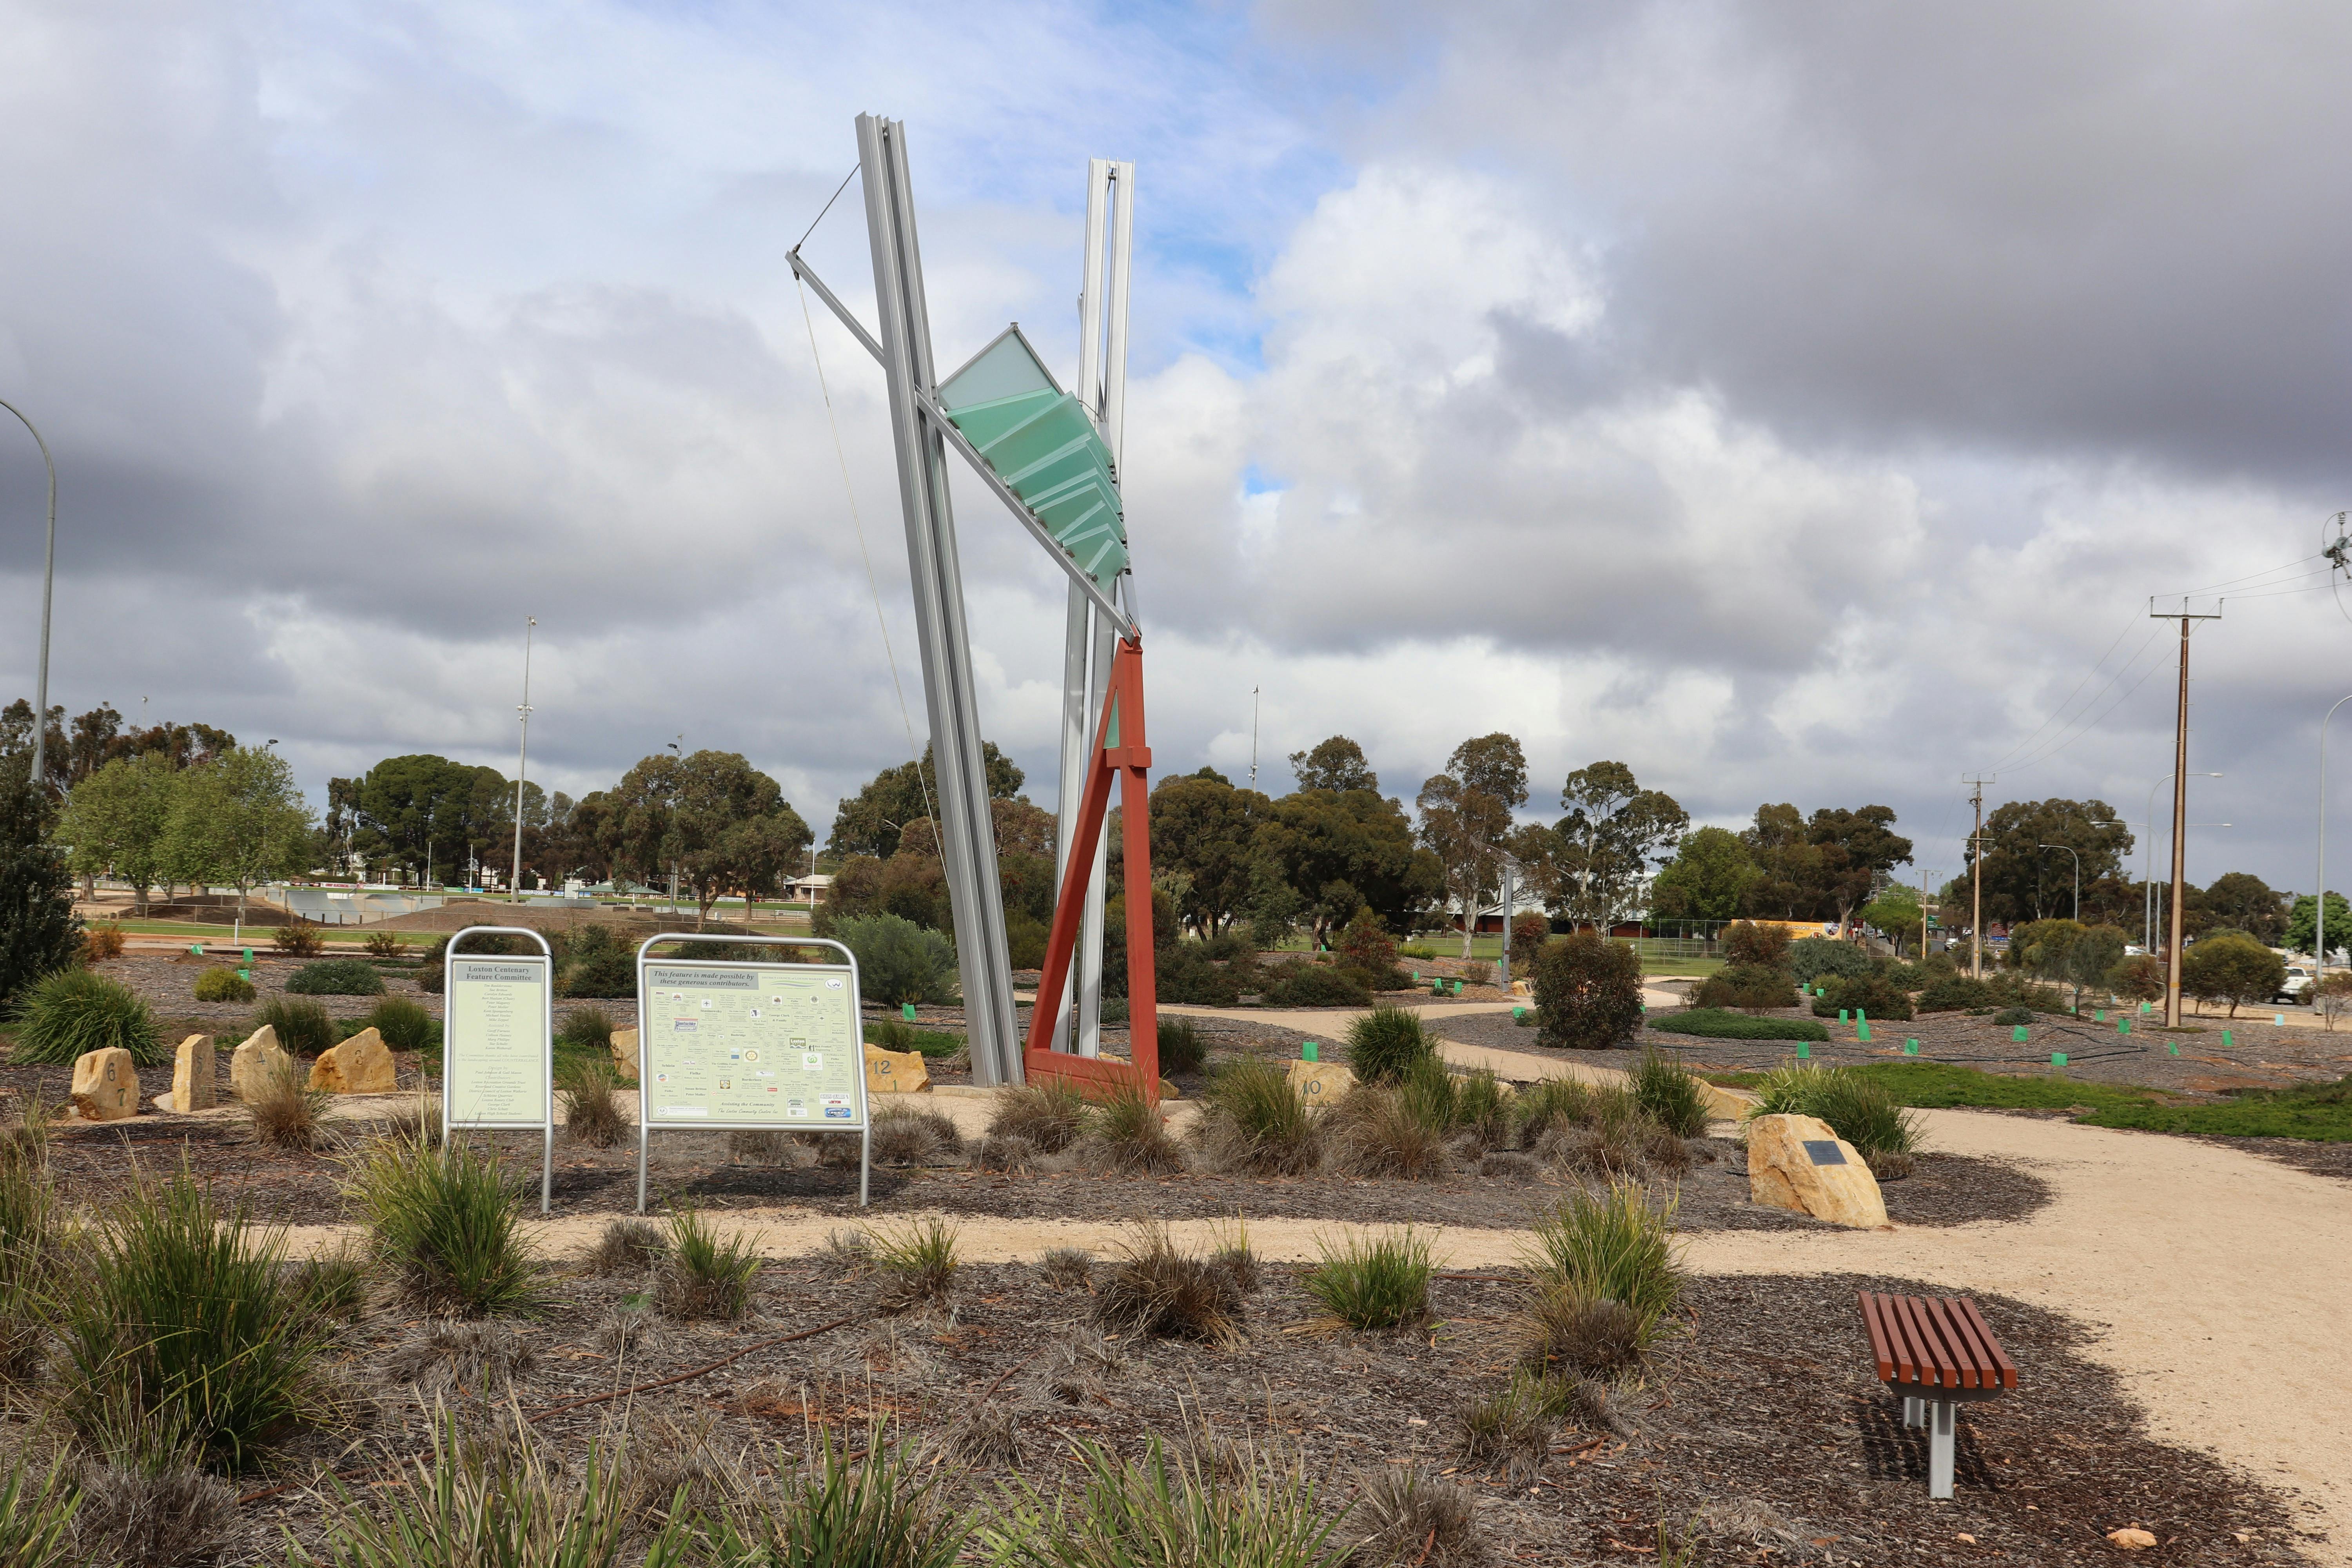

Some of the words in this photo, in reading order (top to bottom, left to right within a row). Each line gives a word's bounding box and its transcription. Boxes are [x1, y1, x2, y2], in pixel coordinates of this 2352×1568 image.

[256, 1051, 266, 1065] 4
[354, 1049, 364, 1065] 3
[107, 1062, 116, 1082] 6
[197, 1056, 203, 1074] 5
[874, 1060, 891, 1074] 12
[367, 1068, 376, 1083] 4
[893, 1079, 897, 1092] 1
[117, 1088, 126, 1107] 7
